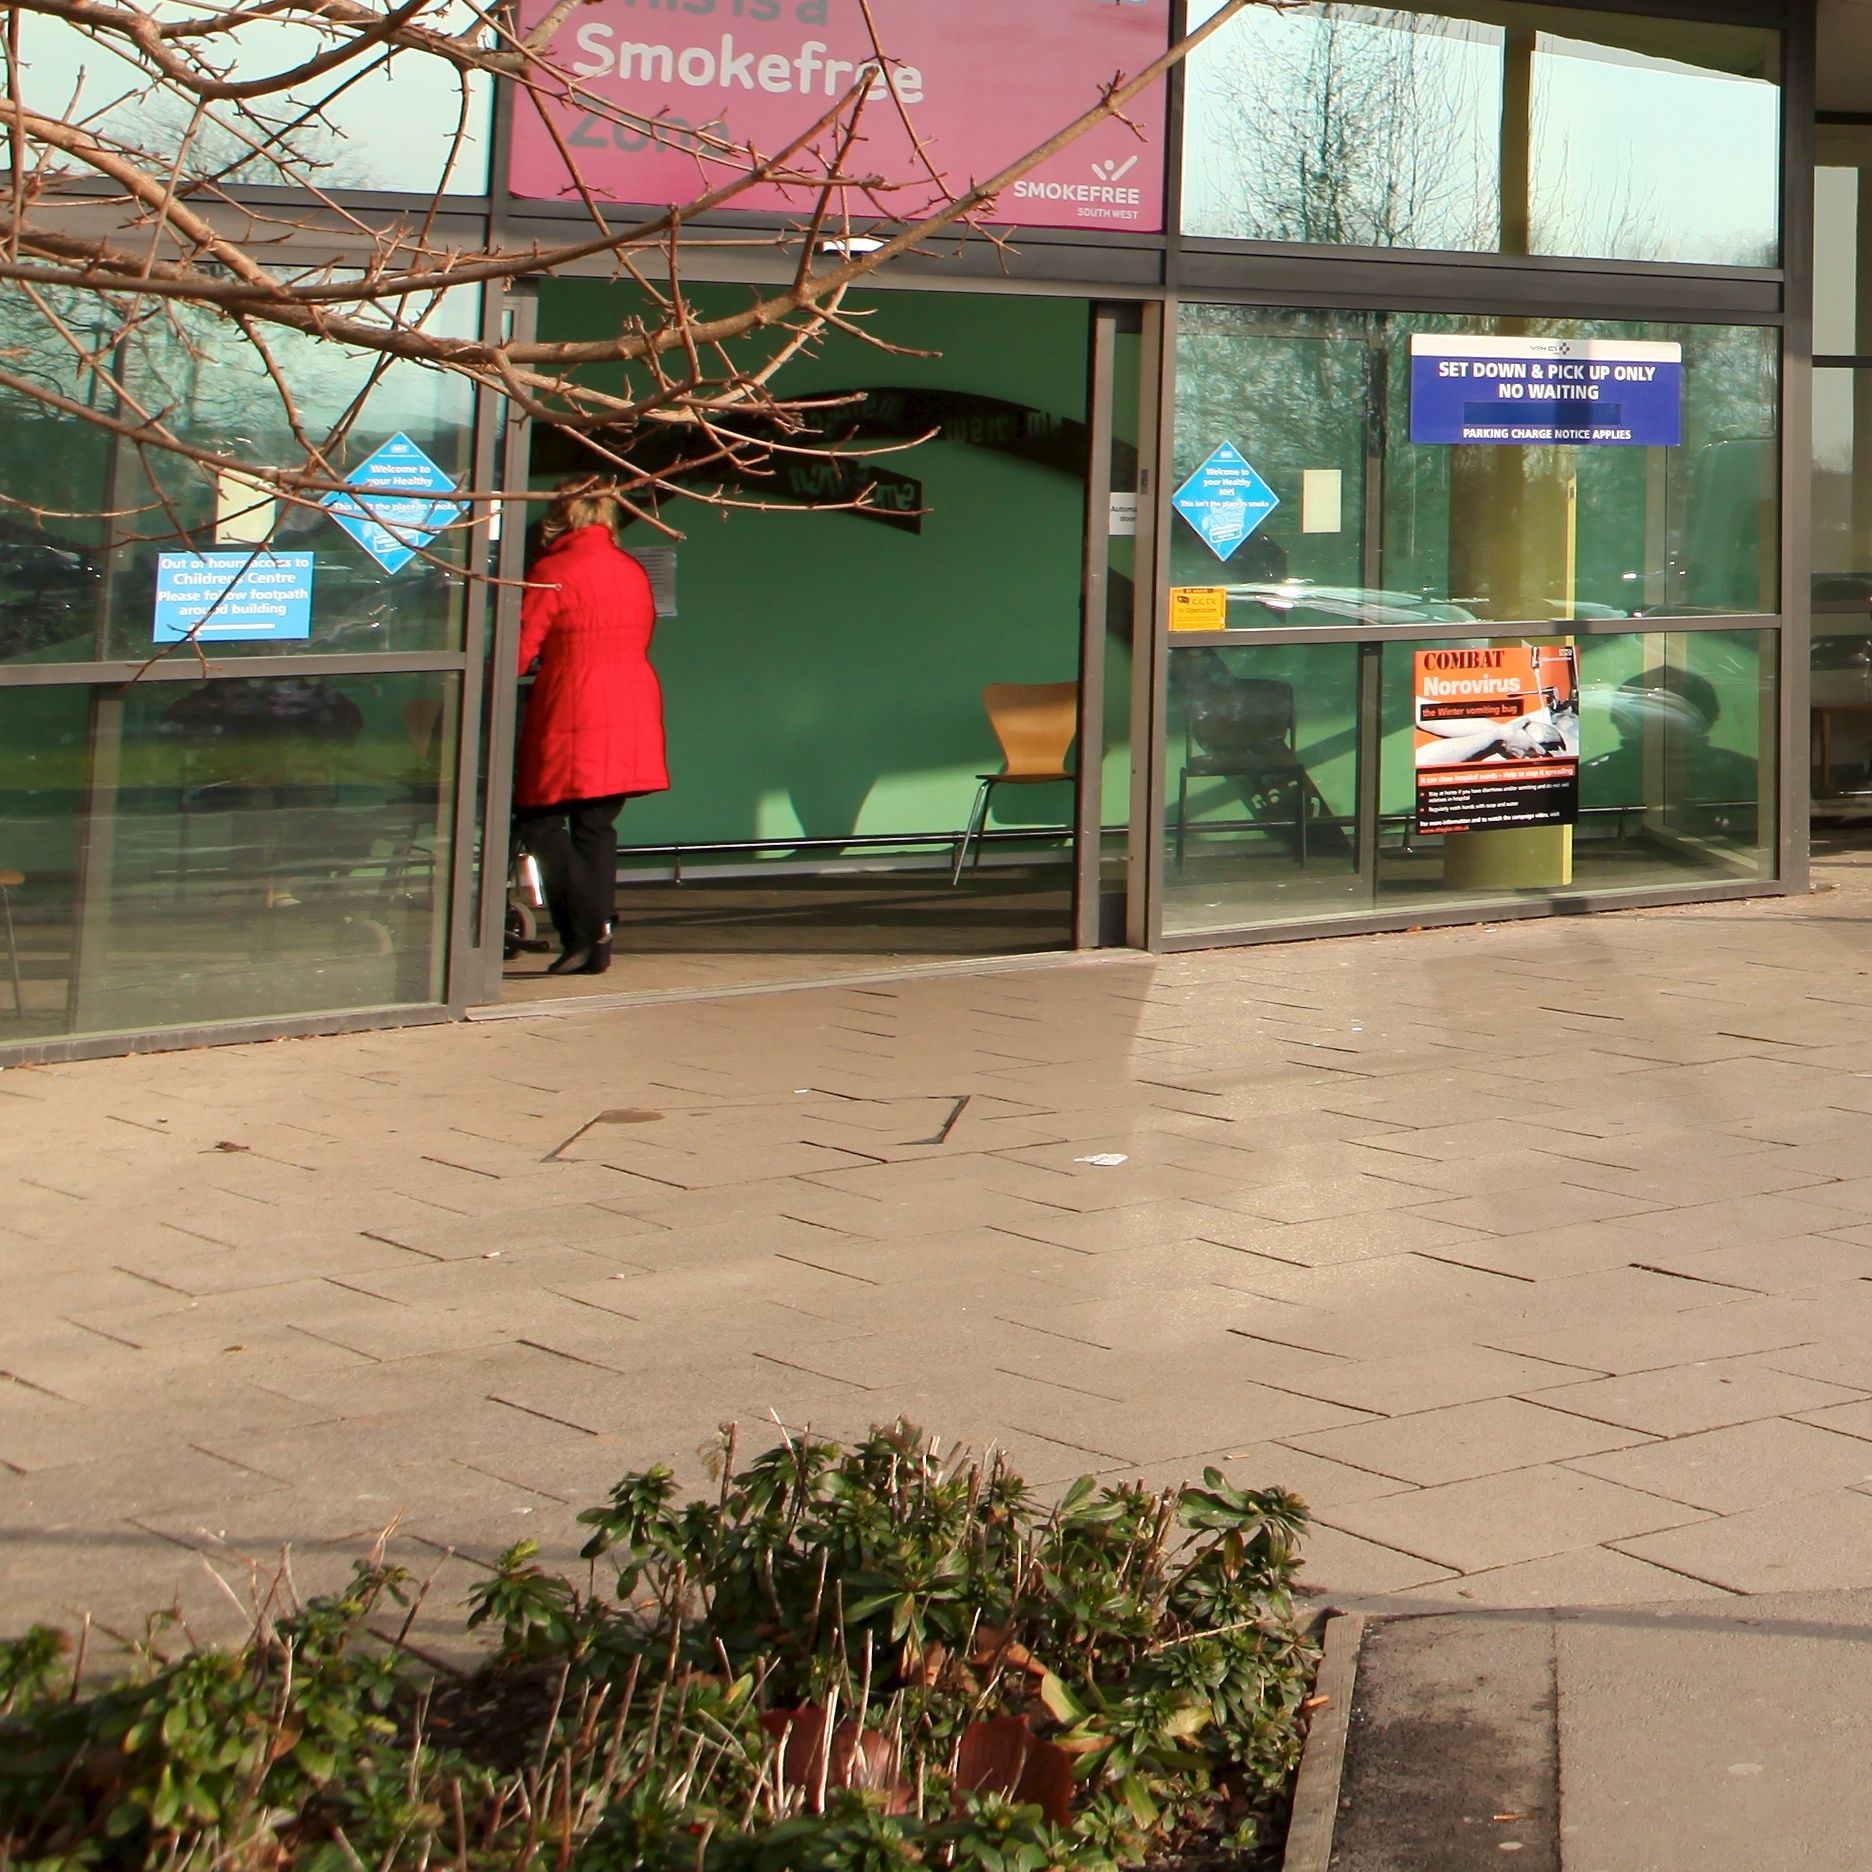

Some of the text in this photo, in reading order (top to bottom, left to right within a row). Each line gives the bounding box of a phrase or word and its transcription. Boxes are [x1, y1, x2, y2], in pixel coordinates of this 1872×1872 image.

[573, 23, 924, 104] Smokefree
[1013, 180, 1140, 205] SMOKEFREE
[1077, 207, 1138, 220] SOUTH WEST
[1438, 361, 1656, 382] SET DOWN & PICK UP ONLY
[1498, 383, 1600, 401] NO WAITING
[1463, 428, 1632, 440] PARKING CHARGE NOTICE APPLIES
[369, 464, 431, 474] Welcome to
[393, 476, 434, 488] Healthy
[161, 558, 187, 570] Out
[295, 558, 310, 568] to
[173, 572, 297, 585] Children Centre
[158, 588, 309, 602] Please folow footpath
[179, 604, 288, 617] aroud building
[1423, 650, 1506, 671] COMBAT
[1423, 673, 1521, 696] Norovirus
[1423, 704, 1518, 718] the Winter vomiting bug
